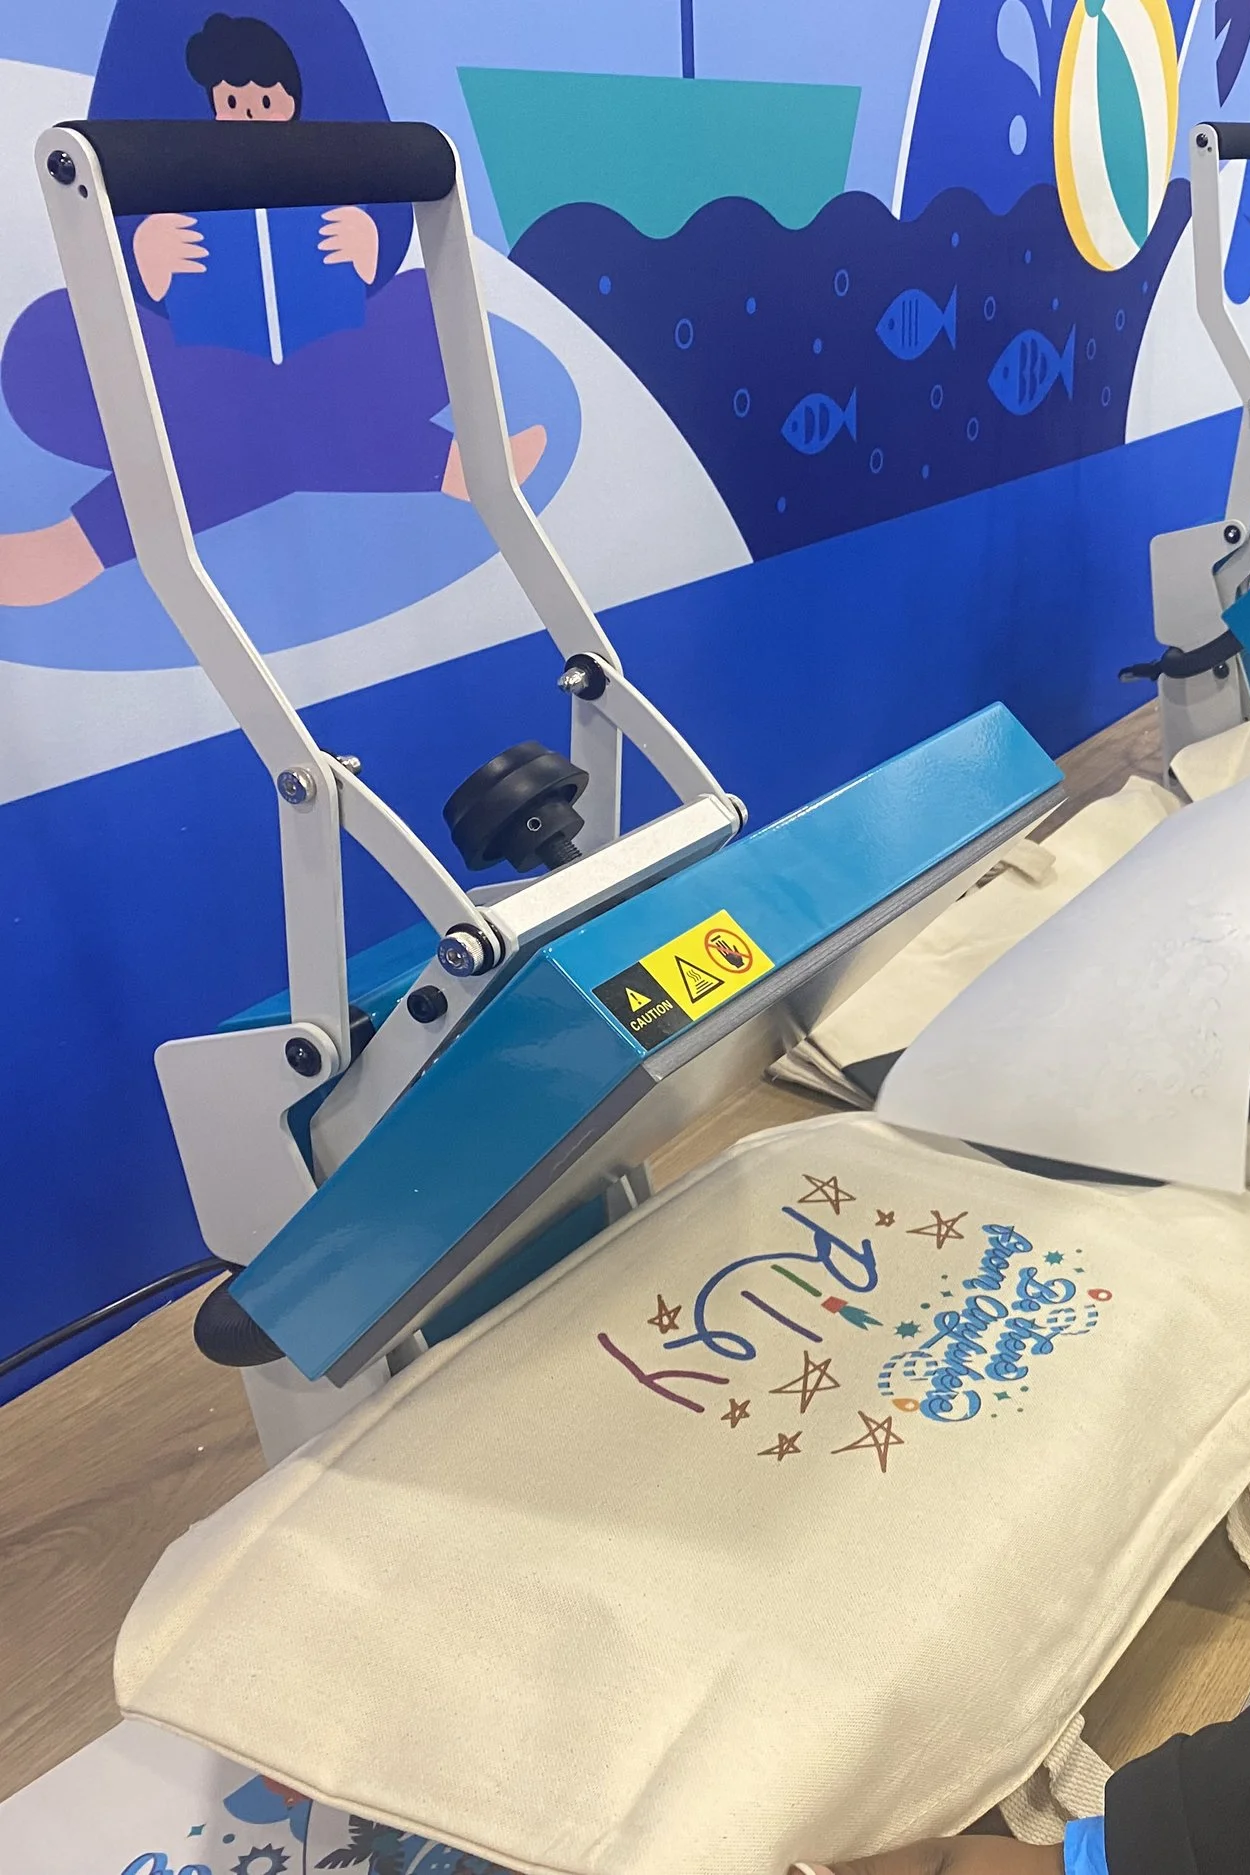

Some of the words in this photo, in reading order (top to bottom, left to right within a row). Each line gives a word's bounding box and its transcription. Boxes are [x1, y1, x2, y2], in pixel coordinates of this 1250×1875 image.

[629, 1000, 674, 1031] CAUTION
[961, 1223, 1034, 1291] from
[1011, 1267, 1076, 1312] Be
[984, 1316, 1057, 1381] there
